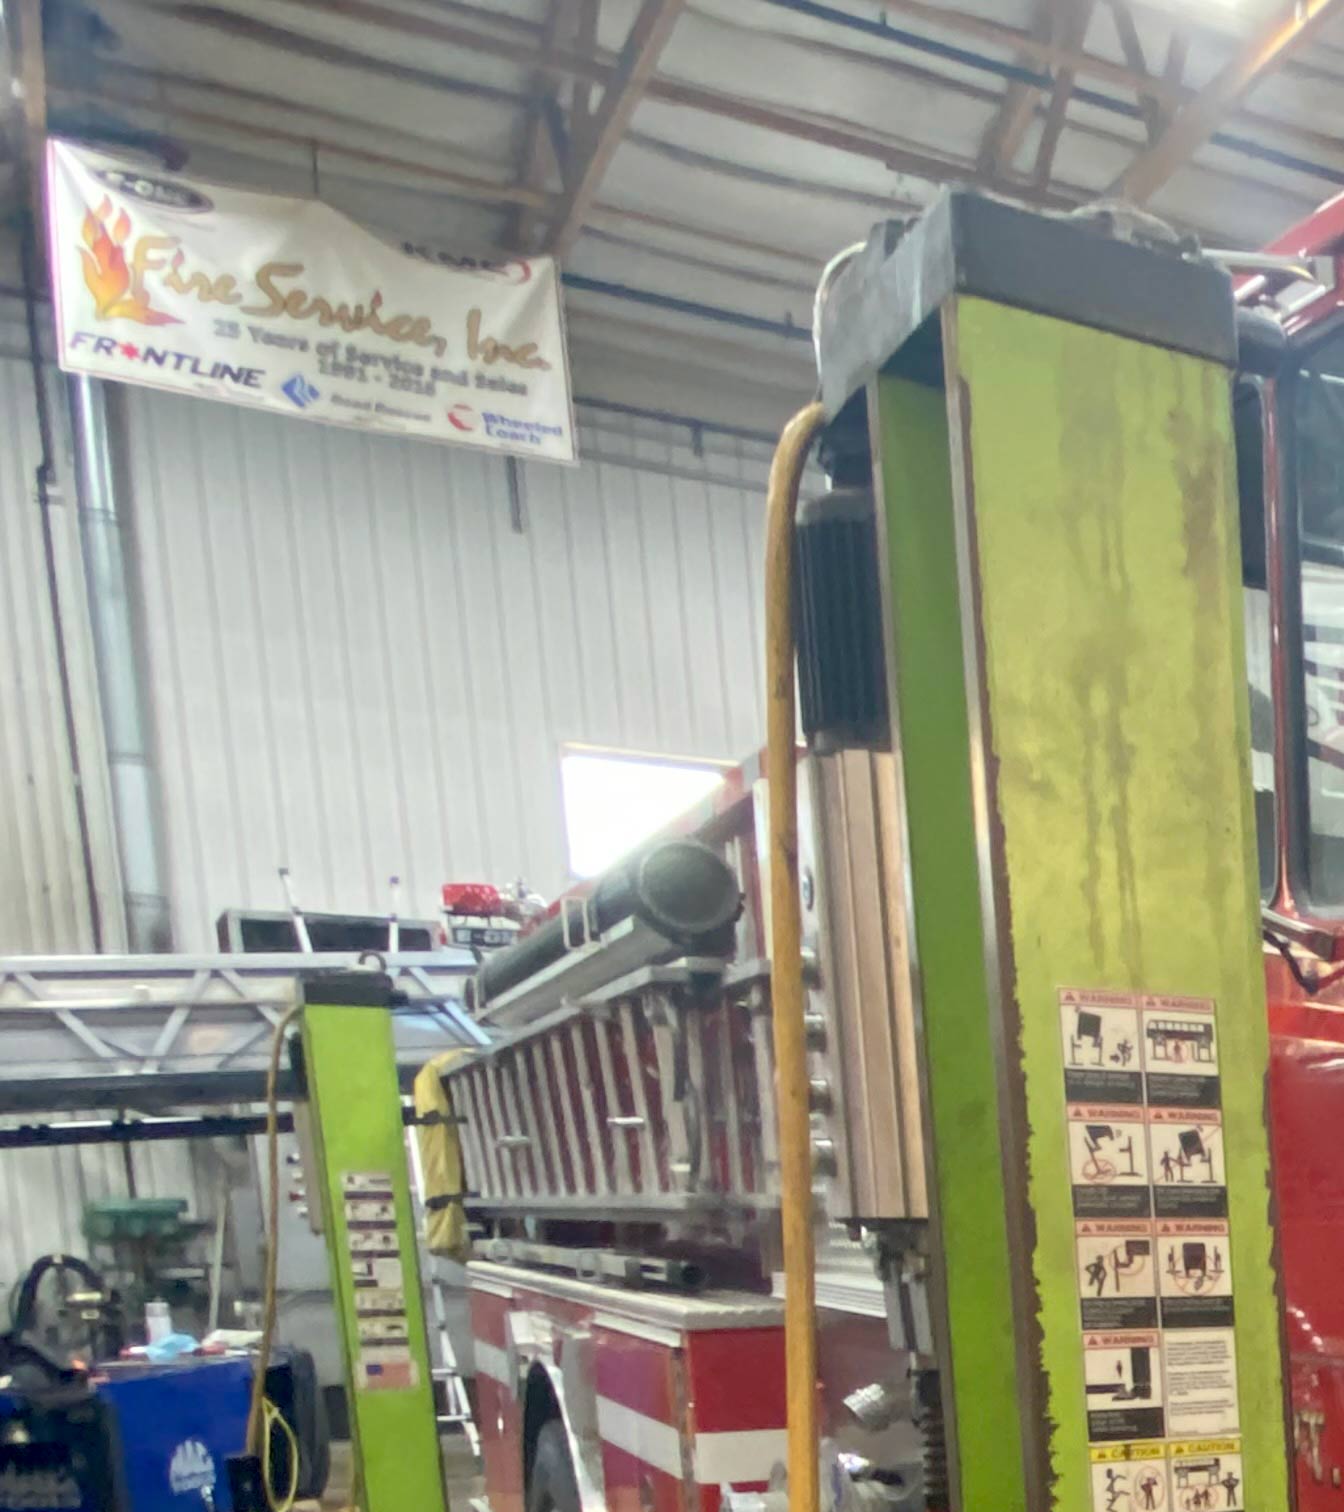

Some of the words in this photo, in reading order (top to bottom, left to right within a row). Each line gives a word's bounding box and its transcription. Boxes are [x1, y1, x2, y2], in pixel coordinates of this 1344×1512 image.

[131, 236, 243, 304] Fire
[1087, 1108, 1141, 1119] WARNING
[1168, 1112, 1218, 1121] WARNING
[1095, 1223, 1148, 1233] WARNING
[1174, 1223, 1225, 1233] WARNING
[1102, 1335, 1155, 1345] WARNING
[1188, 1442, 1235, 1453] CAUTION
[1111, 1447, 1161, 1459] CATION
